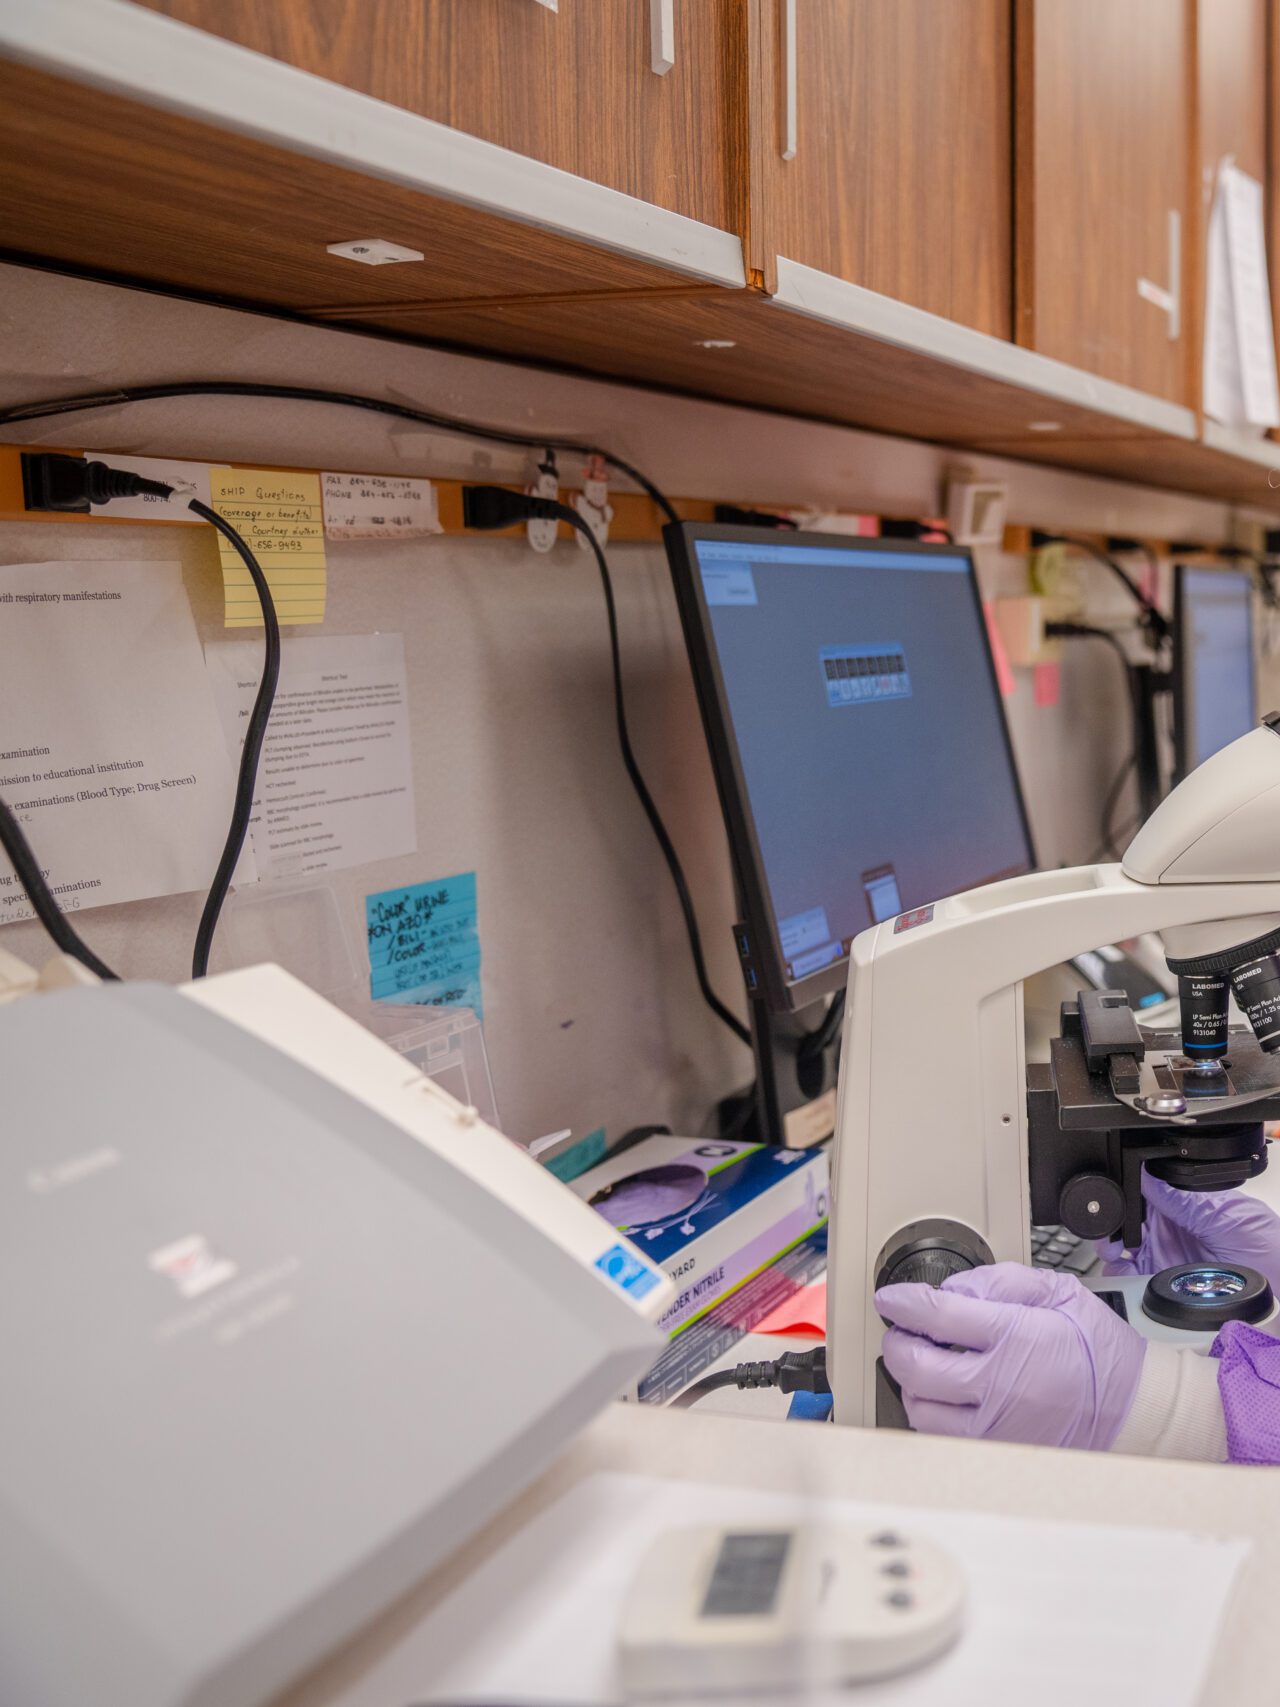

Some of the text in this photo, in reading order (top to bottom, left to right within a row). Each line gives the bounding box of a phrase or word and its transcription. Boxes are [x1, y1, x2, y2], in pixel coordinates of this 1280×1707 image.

[220, 487, 305, 501] SHIP Questions
[15, 592, 61, 604] respiratory
[63, 590, 121, 601] manifestations
[32, 773, 42, 782] to
[43, 764, 96, 781] educational
[97, 759, 144, 774] institution
[14, 794, 75, 811] examinations
[76, 787, 108, 803] (Blood
[109, 785, 136, 798] Type;
[137, 781, 161, 792] Drug
[161, 774, 197, 789] Screen)
[1233, 967, 1262, 983] LABOMED
[692, 1266, 725, 1299] NITRILE
